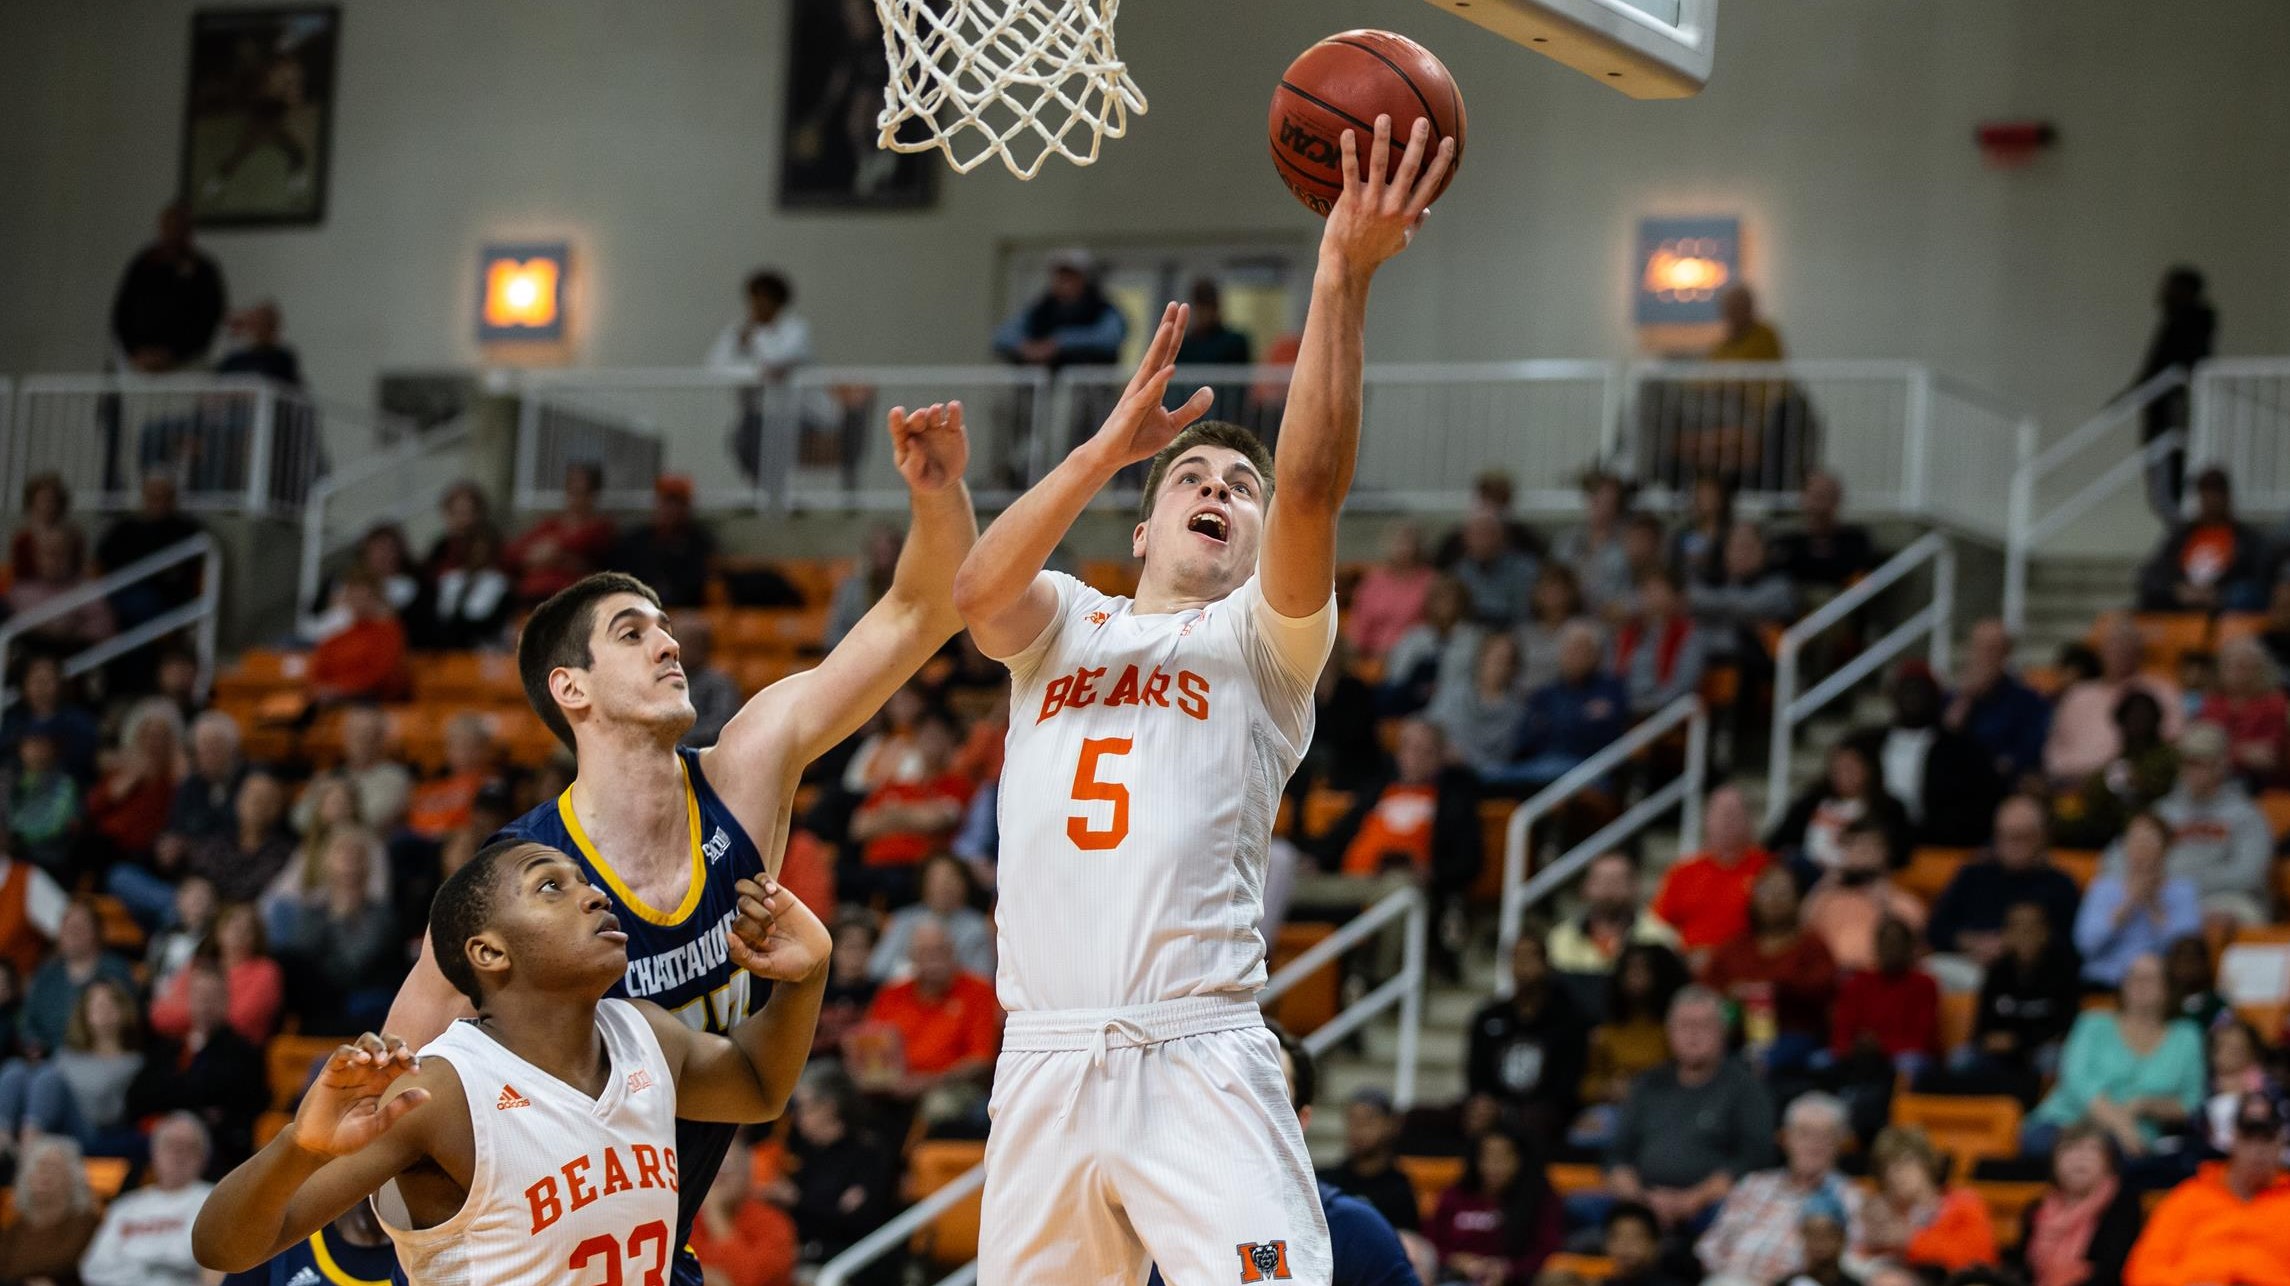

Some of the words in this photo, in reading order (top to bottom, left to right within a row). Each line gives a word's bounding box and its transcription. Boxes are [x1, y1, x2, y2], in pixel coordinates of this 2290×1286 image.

[1036, 664, 1210, 726] BEARS
[1067, 735, 1134, 851] 5
[625, 905, 740, 998] CHATTANO
[525, 1144, 679, 1237] BEARS
